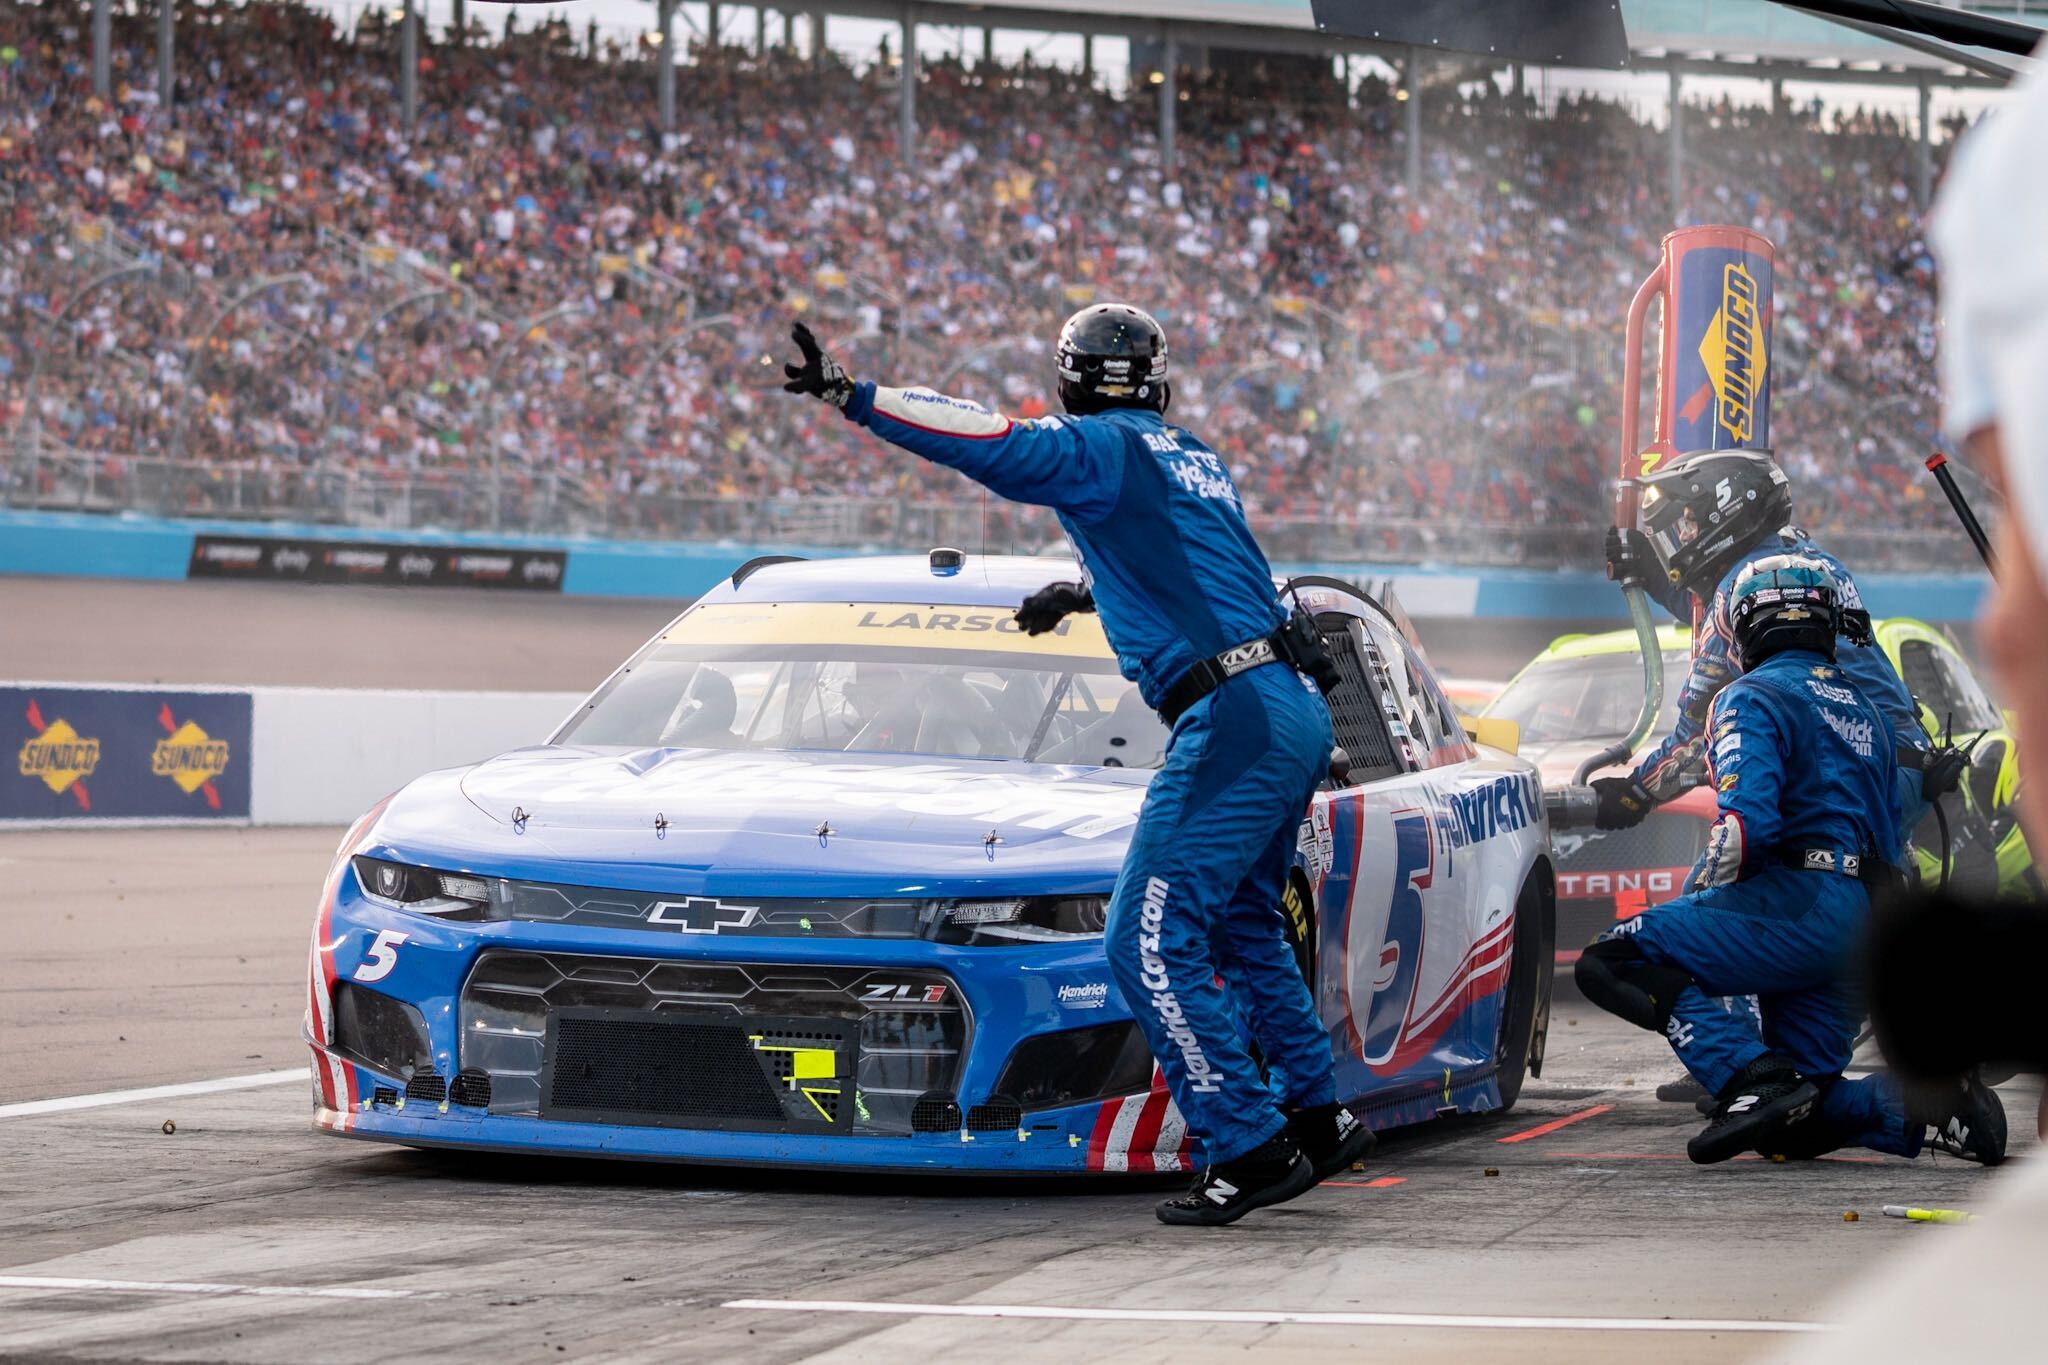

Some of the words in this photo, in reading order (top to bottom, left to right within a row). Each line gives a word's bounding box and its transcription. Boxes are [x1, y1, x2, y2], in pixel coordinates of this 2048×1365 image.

[1721, 265, 1756, 441] SUNOCO
[1715, 477, 1732, 510] 5
[23, 743, 97, 771] SUNOCO
[156, 744, 226, 771] SUNOCO
[1558, 872, 1673, 895] TANG
[1362, 807, 1433, 1067] 5
[352, 929, 410, 983] 5
[858, 984, 947, 1003] ZL1
[1057, 982, 1108, 1002] Hendrick
[1204, 1177, 1239, 1205] N
